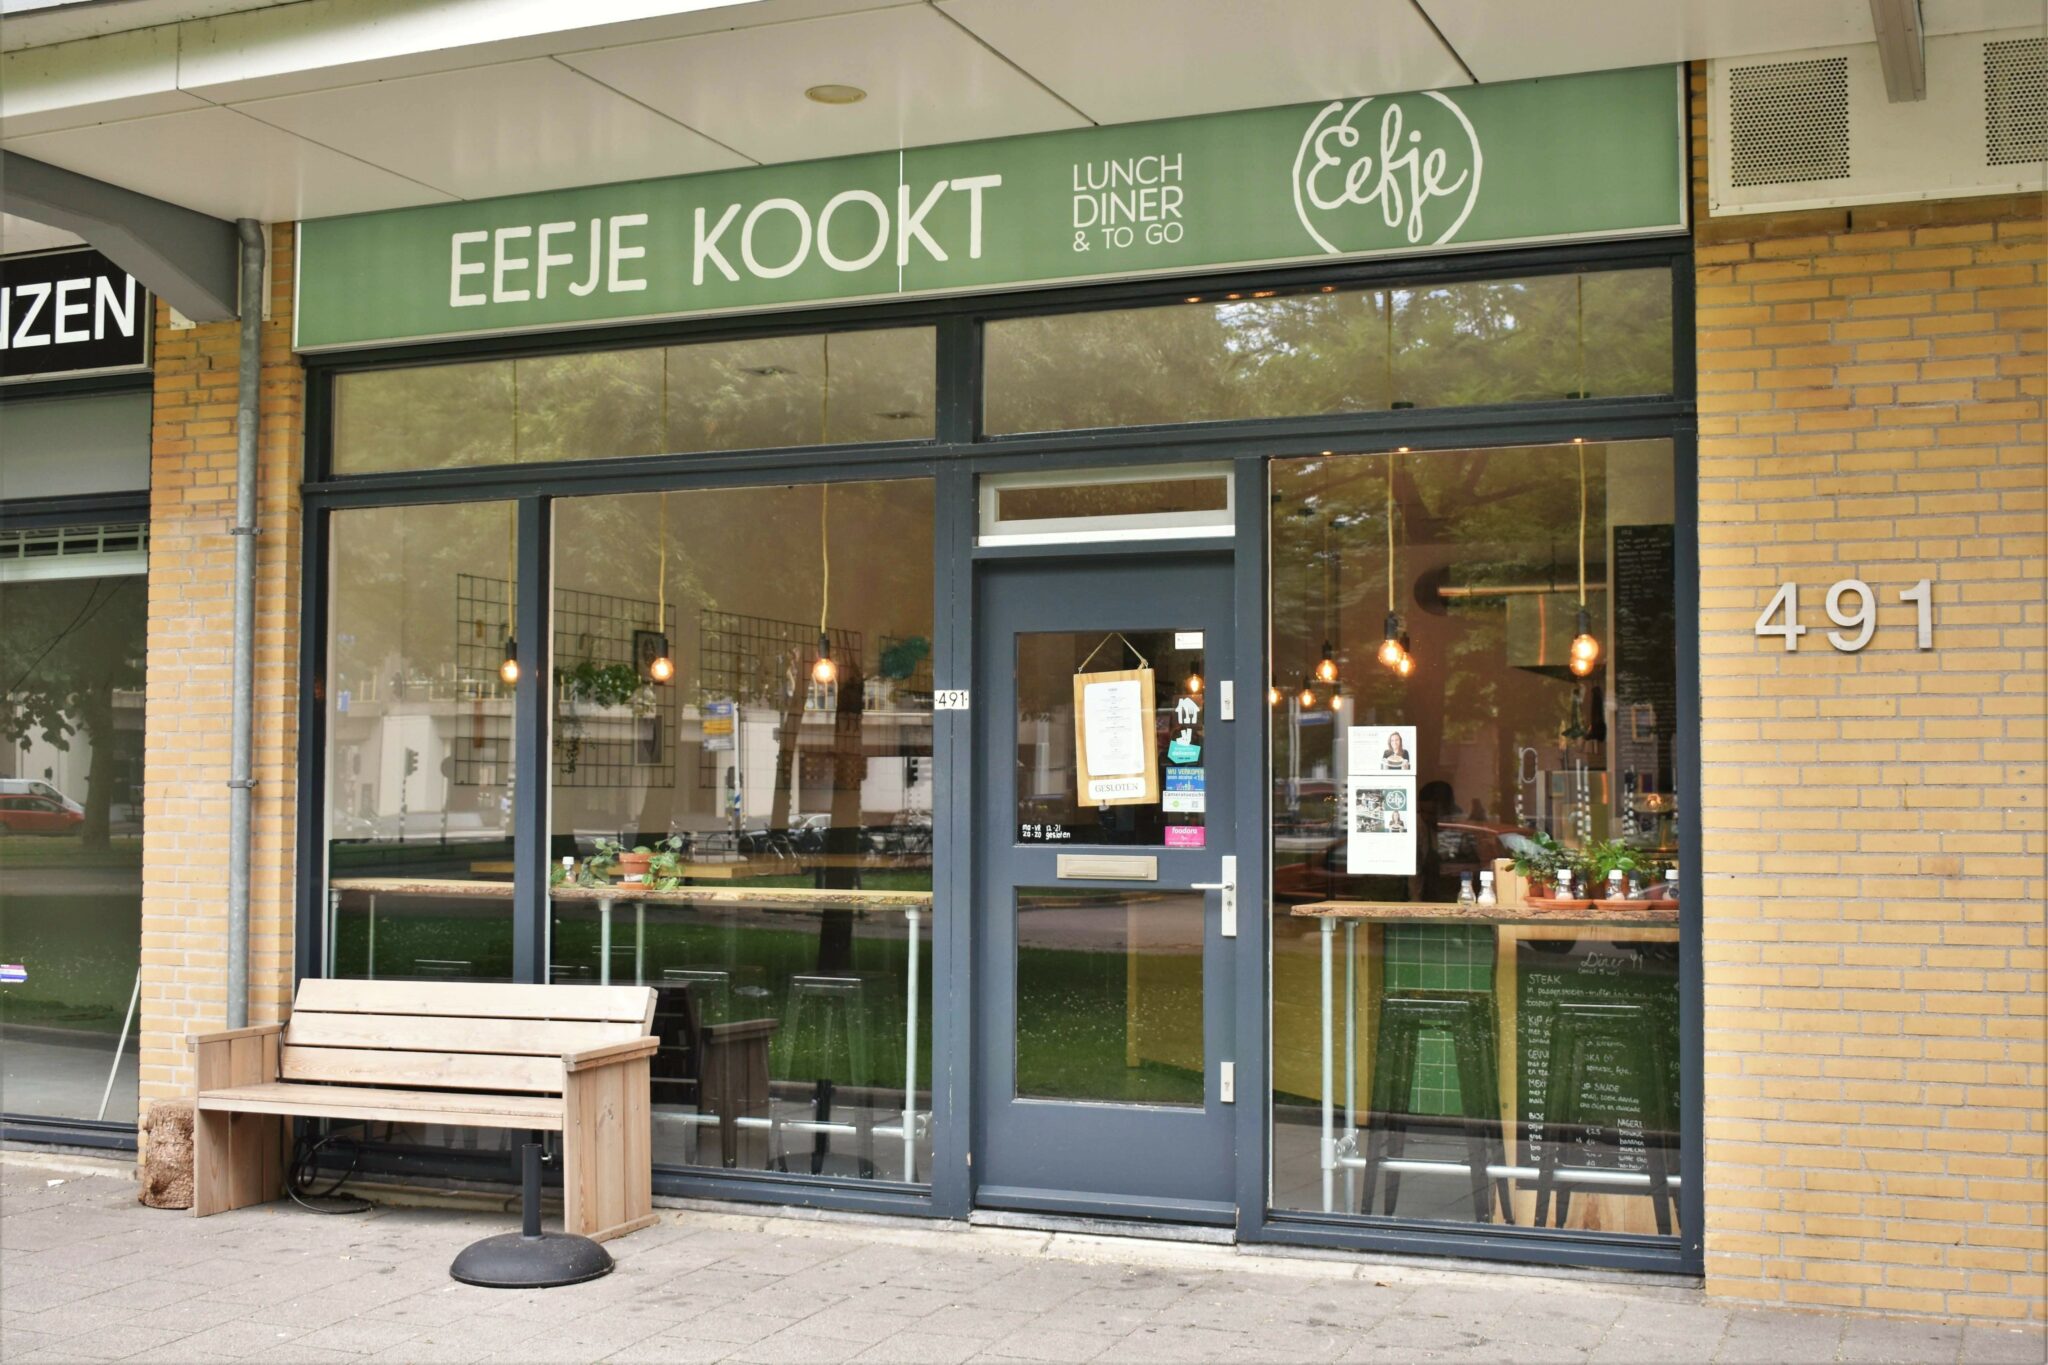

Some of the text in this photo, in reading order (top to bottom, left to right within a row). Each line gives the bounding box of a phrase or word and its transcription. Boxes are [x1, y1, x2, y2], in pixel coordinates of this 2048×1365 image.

[1073, 153, 1183, 191] LUNCH
[1306, 97, 1468, 243] Eefje
[1073, 186, 1184, 228] DINER
[449, 174, 1002, 308] EEFJE KOOKT
[1072, 222, 1184, 252] & TO GO
[1755, 579, 1933, 651] 491
[938, 691, 965, 707] 491
[1094, 783, 1139, 793] GESLOTEN
[1171, 826, 1198, 834] foodora
[1529, 974, 1562, 985] STEAK
